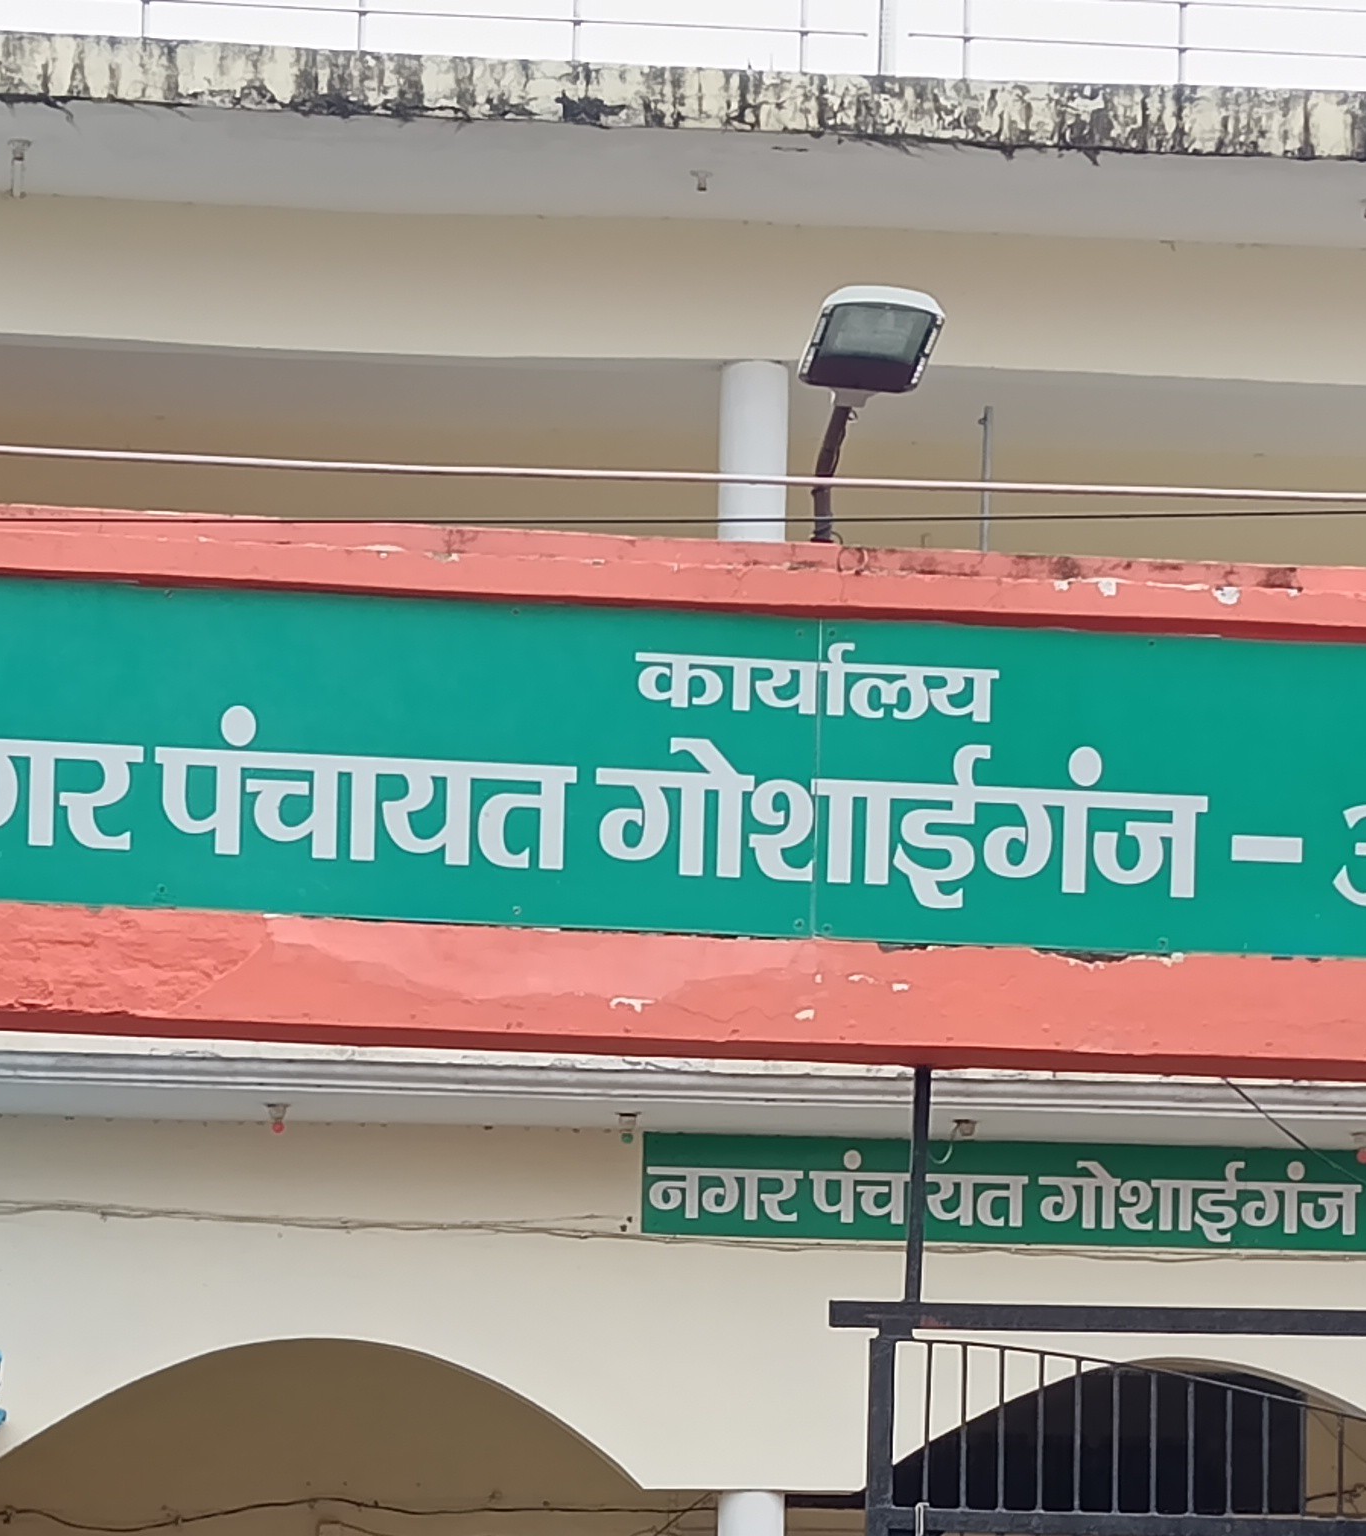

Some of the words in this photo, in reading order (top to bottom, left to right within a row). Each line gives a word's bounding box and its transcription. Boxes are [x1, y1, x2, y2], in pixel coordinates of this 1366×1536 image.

[635, 642, 999, 723] कार्यालय
[155, 705, 577, 871] पंचायत
[596, 738, 1208, 909] गोशाईगंज
[647, 1166, 804, 1224] नगर
[809, 1149, 1029, 1227] पंचयत
[1038, 1160, 1362, 1243] गोशाईगंज
